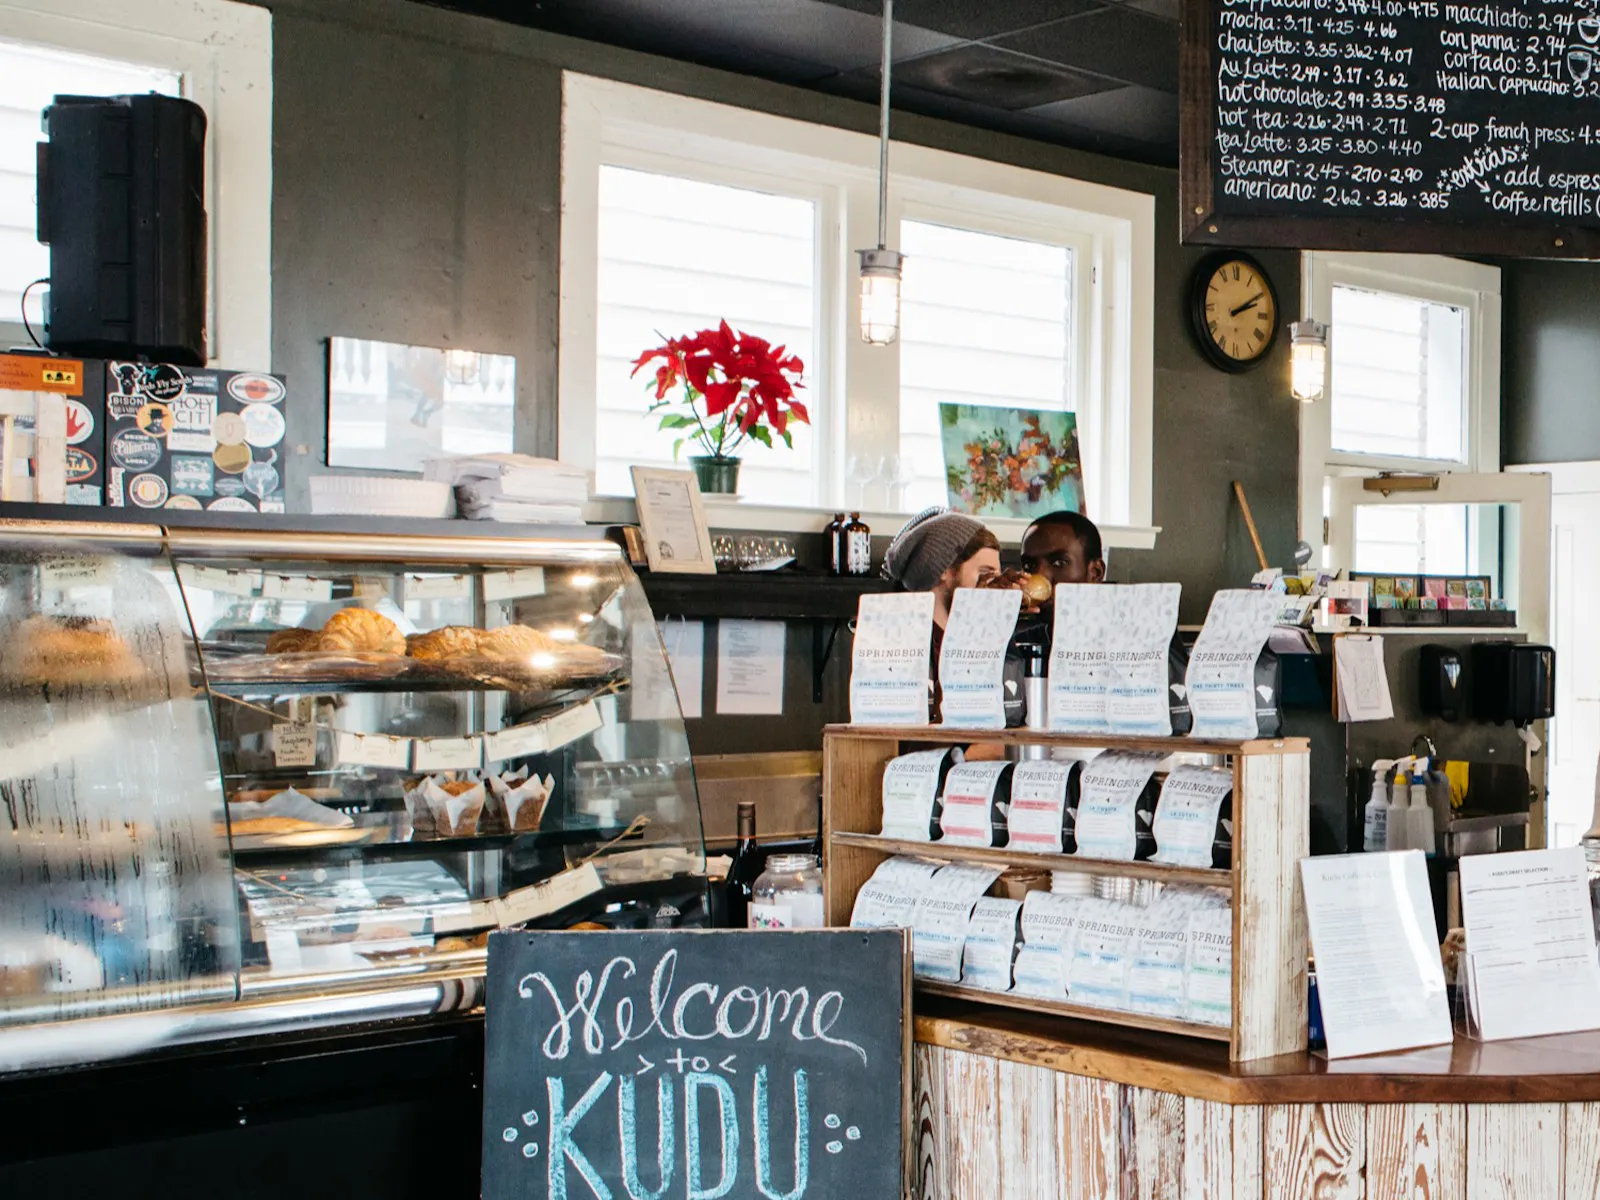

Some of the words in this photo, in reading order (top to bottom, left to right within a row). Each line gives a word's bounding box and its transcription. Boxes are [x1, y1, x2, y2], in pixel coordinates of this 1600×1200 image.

[1409, 1, 1439, 18] 4.75
[1445, 4, 1532, 29] macchiato:
[1538, 13, 1574, 35] 2.94
[1220, 11, 1281, 31] mocha:
[1284, 16, 1313, 34] 3.71
[1323, 17, 1353, 34] 4.25
[1364, 21, 1398, 38] 4.66
[1304, 40, 1337, 58] 3.35
[1344, 43, 1375, 61] 3.62
[1380, 46, 1413, 65] 4.07
[1440, 30, 1467, 48] con
[1471, 32, 1521, 55] panna:
[1526, 36, 1566, 57] 2.94
[1291, 64, 1319, 83] 2.49
[1332, 65, 1363, 85] 3.17
[1373, 69, 1409, 89] 3.62
[1443, 50, 1521, 75] cortado:
[1525, 57, 1562, 81] 3.17
[1436, 70, 1496, 91] italian
[1218, 77, 1252, 103] hot
[1253, 79, 1331, 110] chocolate:
[1331, 90, 1364, 108] 2.99
[1371, 93, 1408, 110] 3.35
[1414, 95, 1446, 113] 3.48
[1218, 105, 1249, 128] hot
[1252, 107, 1290, 130] tea:
[1292, 112, 1326, 130] 2.26
[1332, 113, 1364, 131] 2.49
[1372, 117, 1408, 135] 2.71
[1216, 129, 1242, 153] tea
[1296, 136, 1333, 153] 3.25
[1339, 138, 1378, 154] 3.80
[1388, 139, 1422, 157] 4.40
[1430, 117, 1479, 143] 2-cup
[1485, 116, 1531, 144] french
[1535, 127, 1575, 149] press:
[1303, 163, 1344, 181] 2.45
[1350, 164, 1382, 183] 2.70
[1390, 168, 1423, 186] 2.90
[1504, 165, 1543, 187] add
[1224, 178, 1316, 203] americano:
[1322, 186, 1362, 206] 2.62
[1373, 189, 1408, 208] 3.26
[1544, 192, 1592, 216] refills
[112, 396, 144, 406] BISON
[858, 649, 925, 658] SPRINGBOK
[944, 649, 1001, 660] SPRINGBOK
[1109, 650, 1164, 662] SPRINGBOK
[1194, 652, 1256, 662] SPRINGBOK
[1017, 770, 1066, 782] SPRINGBOK
[1084, 775, 1143, 789] SPRINGBOK
[1167, 779, 1225, 794] SPRINGBOK
[862, 889, 917, 906] SPRINGBOK
[920, 897, 970, 912] SPRINGBOK
[975, 907, 1014, 919] PRINGBOK
[1023, 913, 1075, 928] SPRINGBOK
[1077, 920, 1136, 938] SPRINGBOK
[518, 948, 868, 1068] Welcome
[666, 1048, 709, 1074] to
[547, 1063, 809, 1200] KUDU
